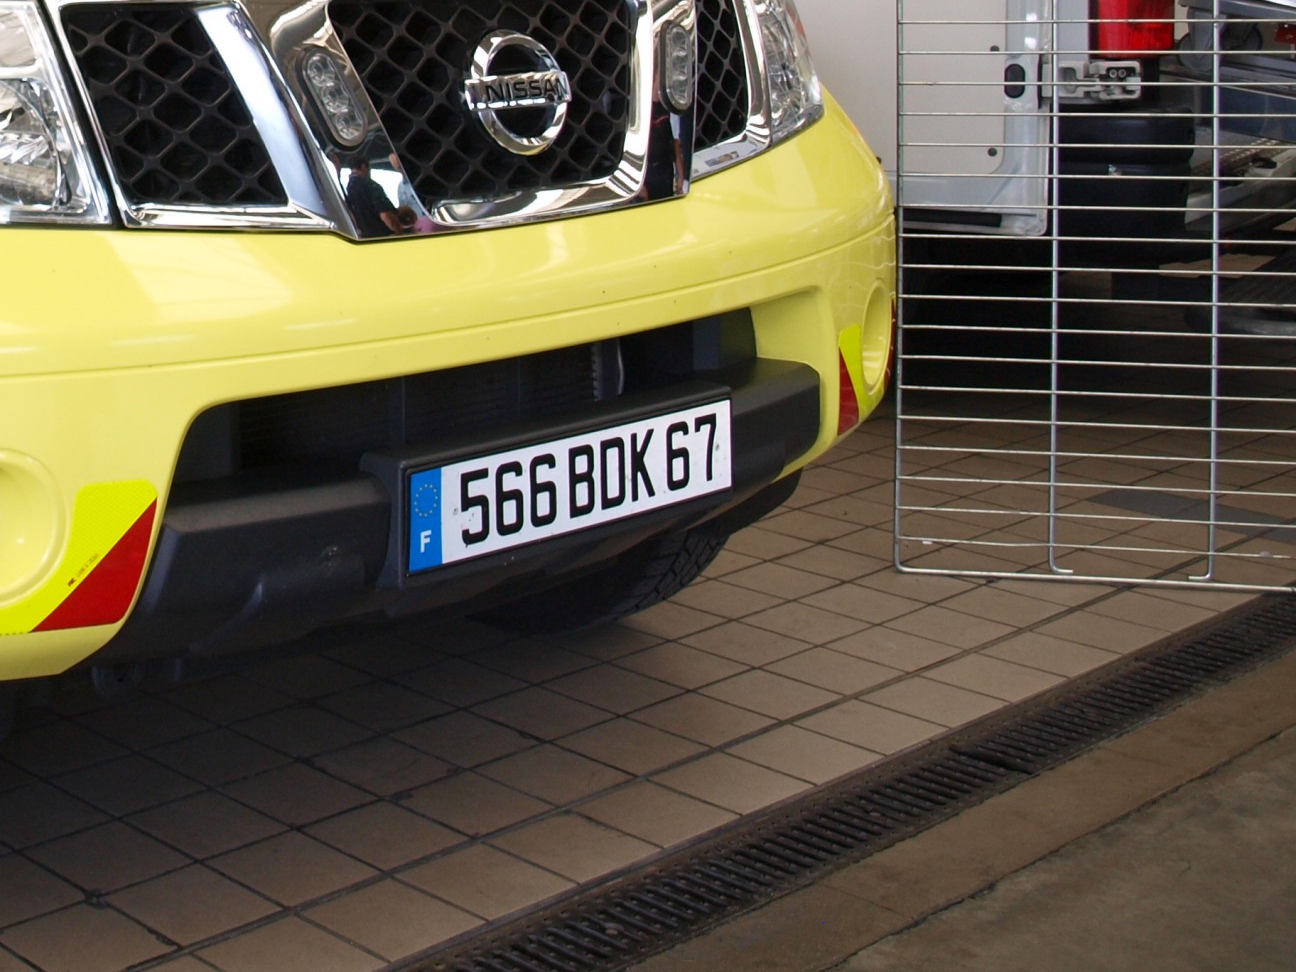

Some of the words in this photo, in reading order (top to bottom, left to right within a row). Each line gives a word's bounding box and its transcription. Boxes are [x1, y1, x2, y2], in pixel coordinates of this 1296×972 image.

[485, 77, 569, 102] NISSAN
[460, 453, 557, 546] 566
[568, 428, 656, 518] BDK
[665, 413, 717, 492] 67
[419, 530, 432, 553] F
